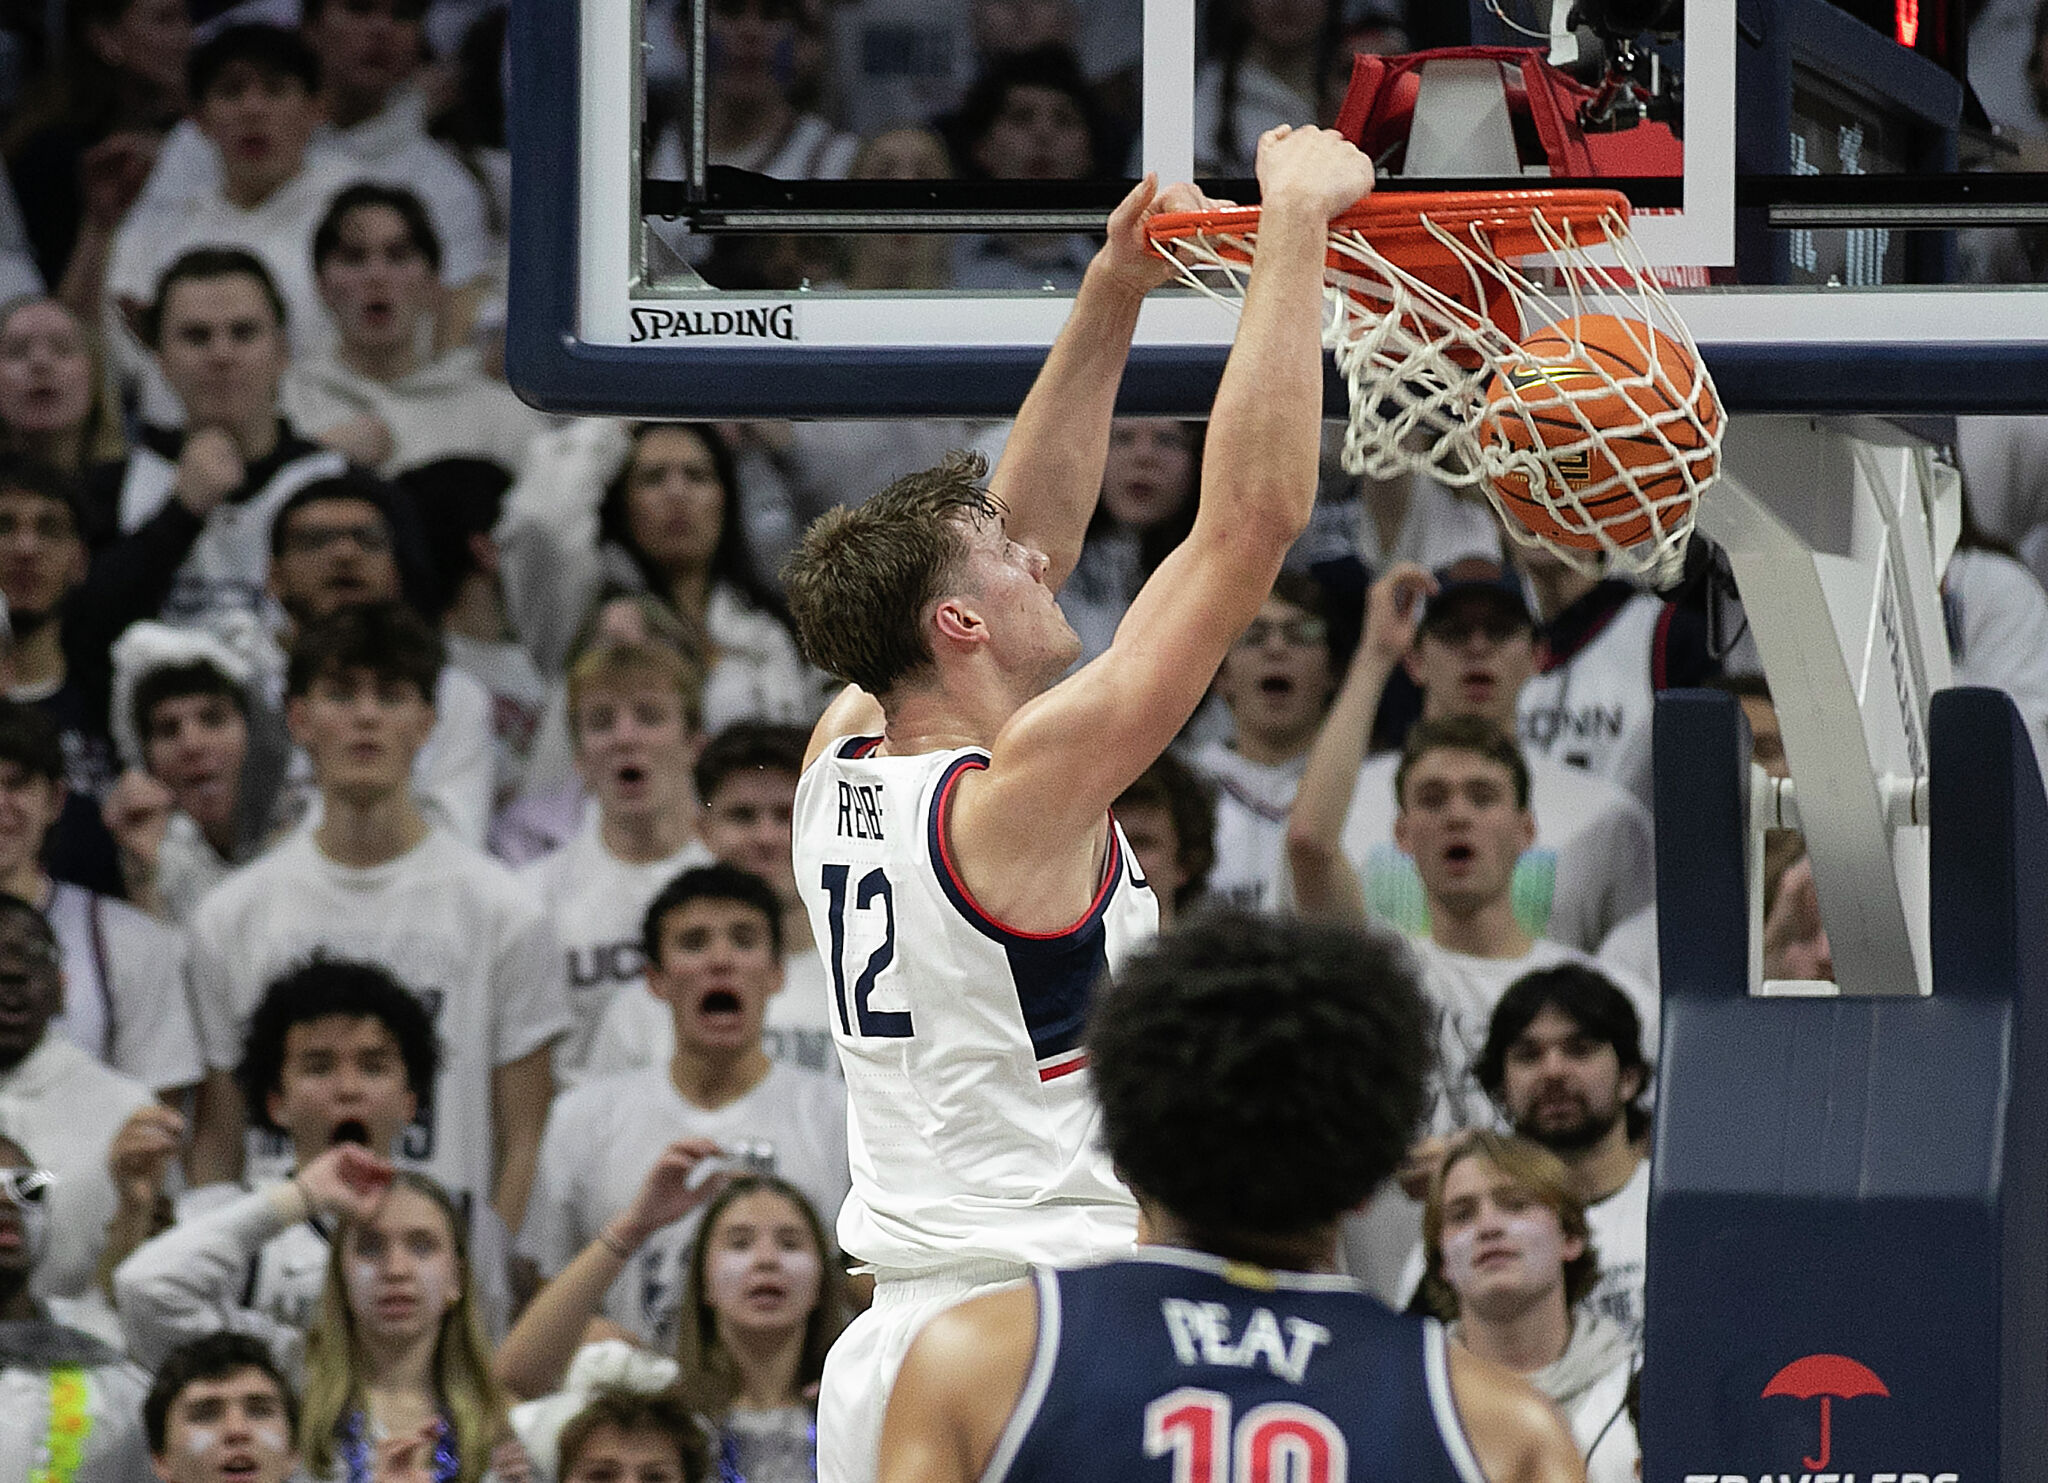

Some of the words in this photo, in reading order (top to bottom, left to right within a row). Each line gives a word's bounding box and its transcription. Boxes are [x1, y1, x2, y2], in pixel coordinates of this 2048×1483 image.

[630, 304, 794, 342] SPALDING
[821, 864, 915, 1037] 12
[1161, 1297, 1332, 1385] PEAT
[1142, 1386, 1349, 1483] 10
